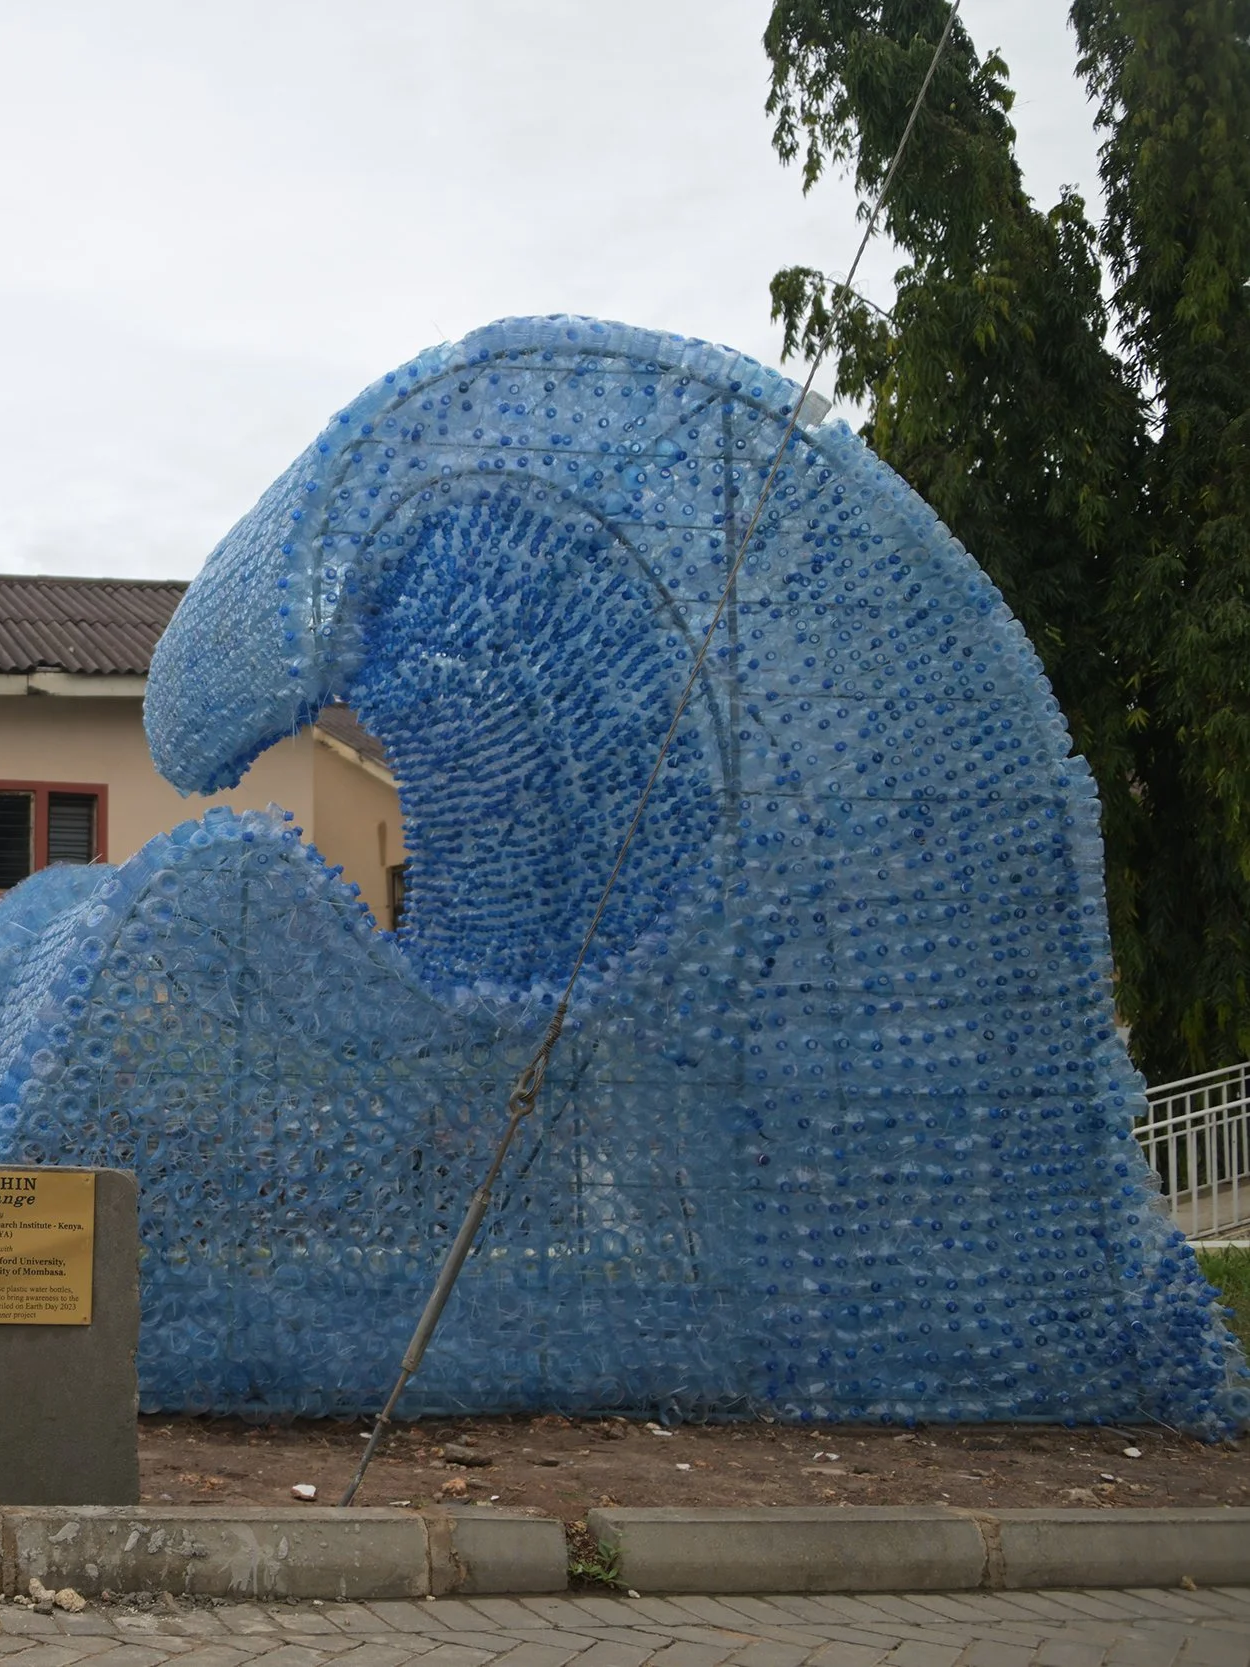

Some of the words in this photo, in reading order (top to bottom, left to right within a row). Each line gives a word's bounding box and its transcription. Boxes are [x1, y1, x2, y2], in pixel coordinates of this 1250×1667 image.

[20, 1221, 51, 1229] Institute
[20, 1257, 65, 1267] University,
[12, 1267, 22, 1275] of
[23, 1268, 66, 1276] Mombasa.
[7, 1294, 24, 1302] bring
